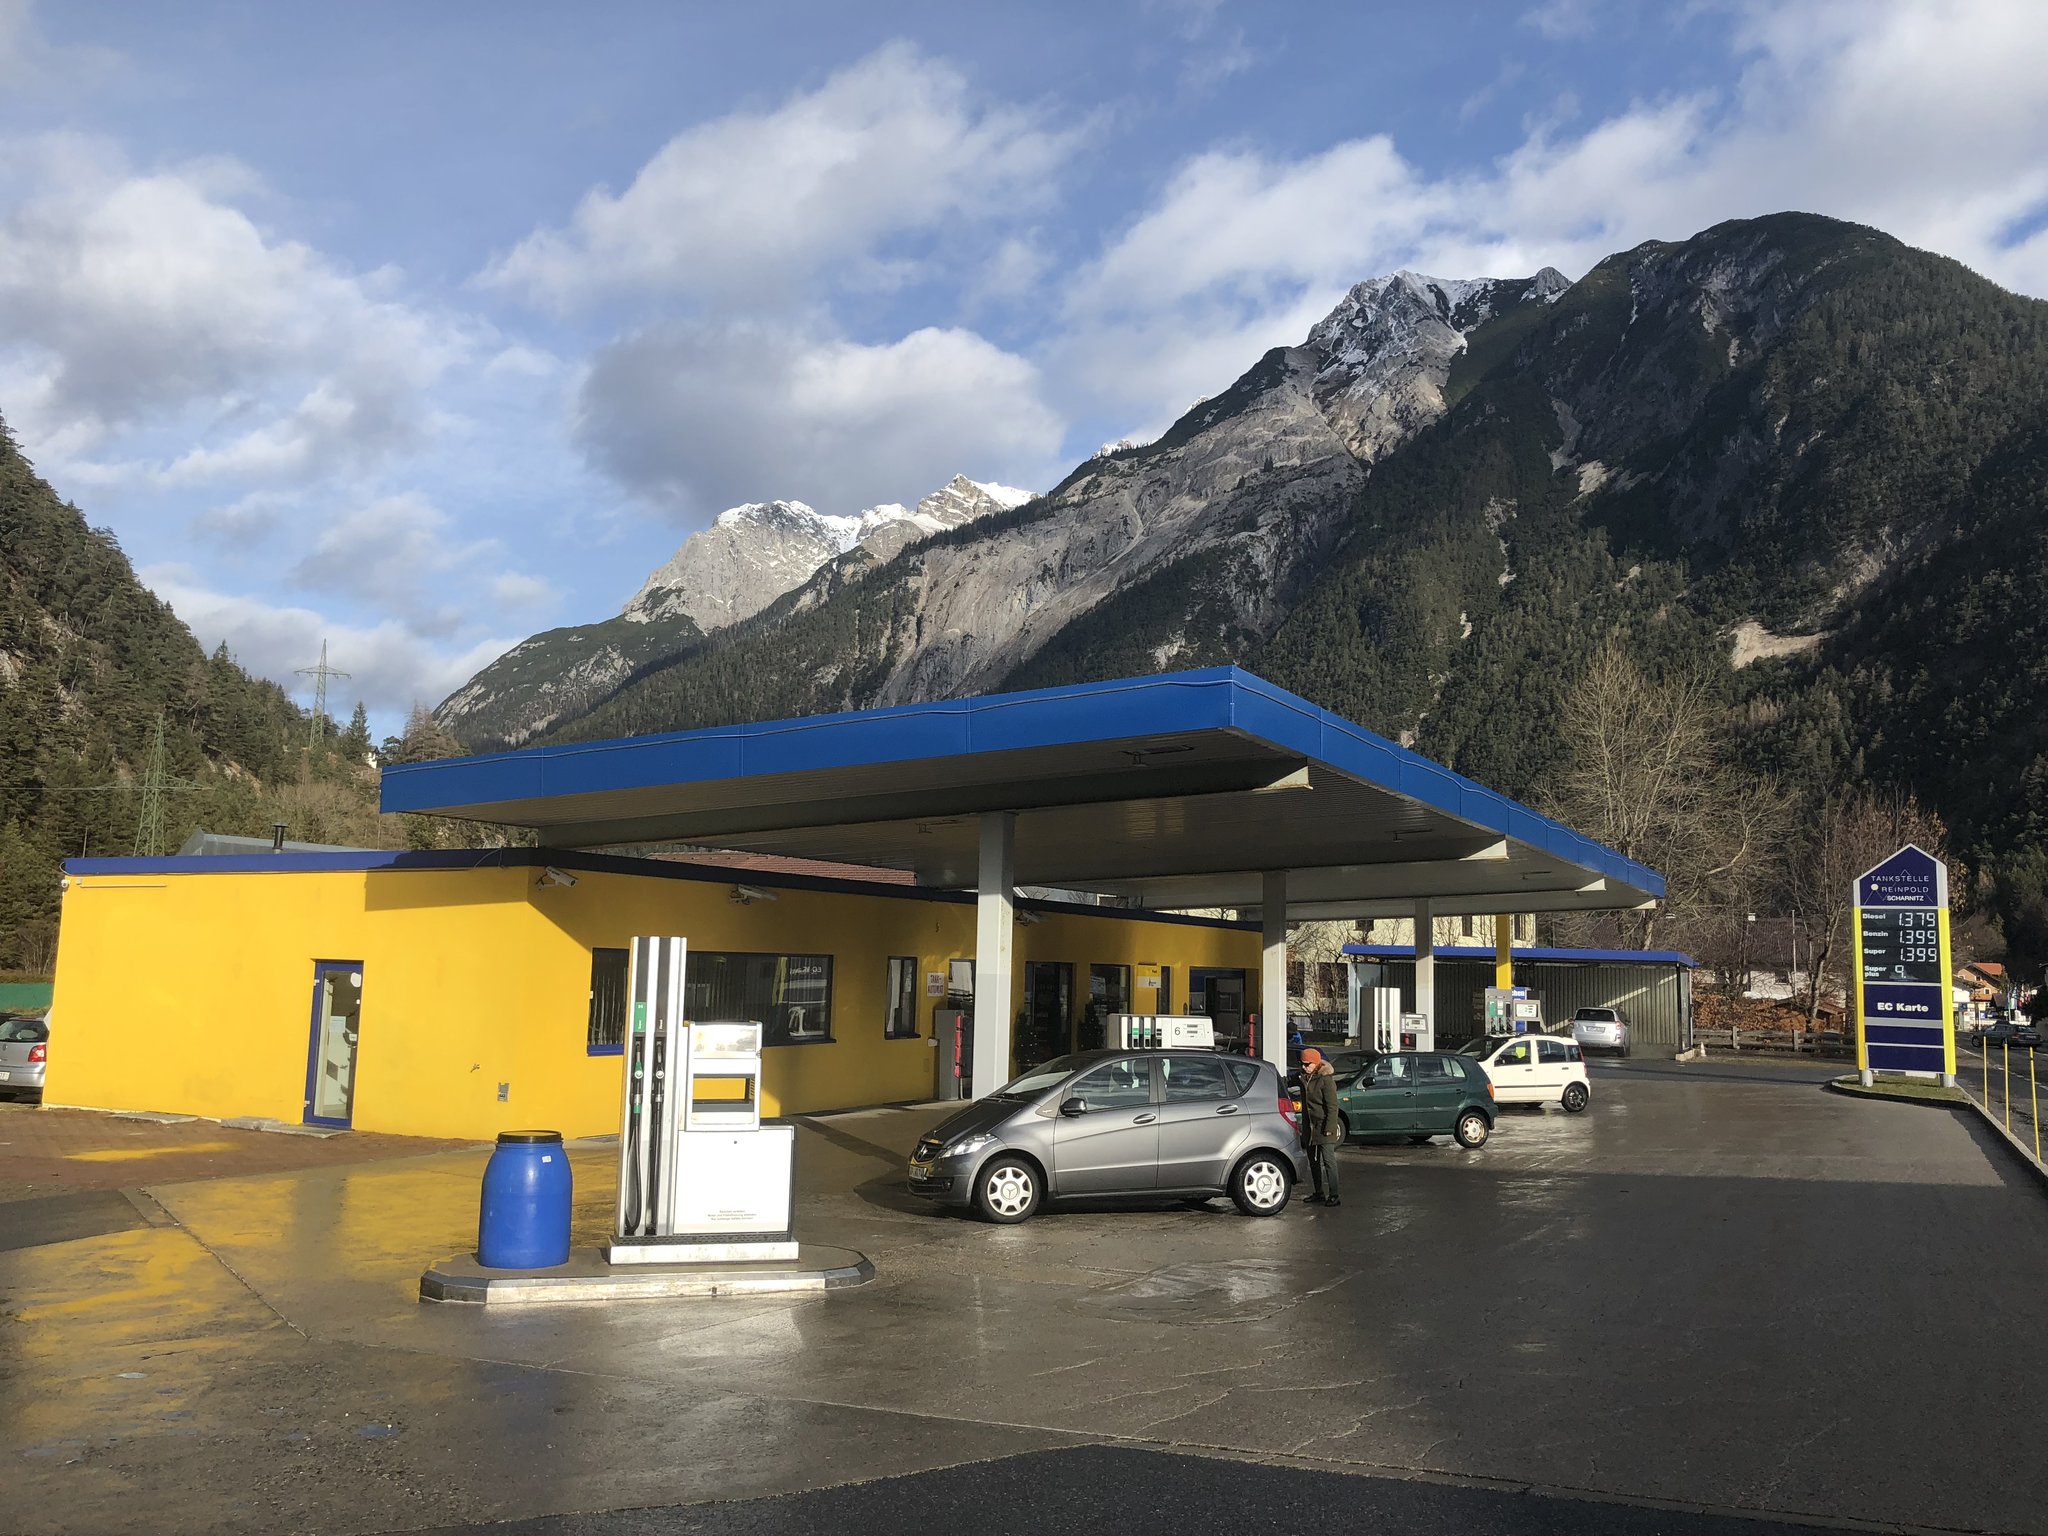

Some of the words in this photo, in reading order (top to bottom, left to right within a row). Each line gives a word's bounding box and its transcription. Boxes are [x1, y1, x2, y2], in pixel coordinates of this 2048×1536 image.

[1899, 912, 1936, 927] 1.379
[1899, 929, 1936, 944] 1.399
[1900, 947, 1937, 962] 1.399
[1877, 1002, 1893, 1011] EC
[1896, 1002, 1929, 1012] Karte
[1174, 1026, 1181, 1036] 6
